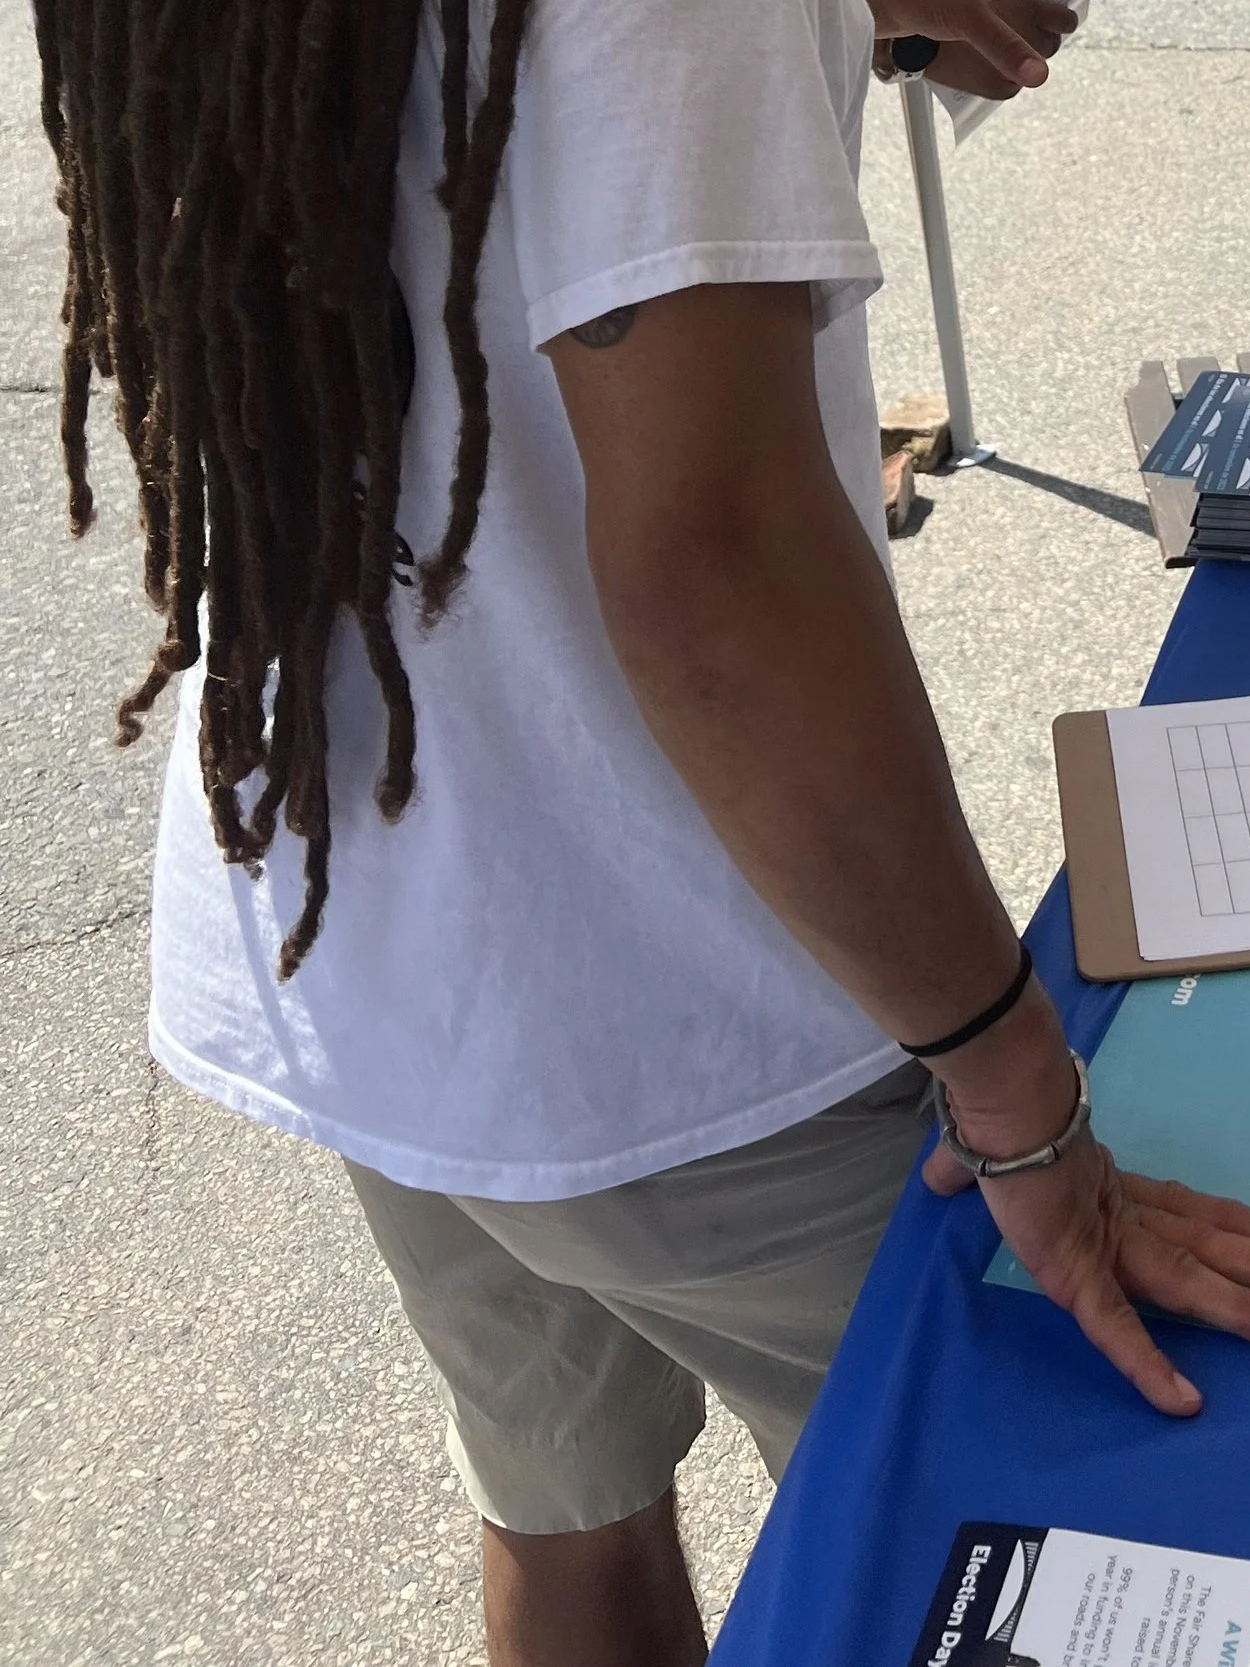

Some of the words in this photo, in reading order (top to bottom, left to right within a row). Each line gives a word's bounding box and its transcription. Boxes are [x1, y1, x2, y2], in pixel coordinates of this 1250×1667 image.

[1105, 1554, 1117, 1579] year
[948, 1545, 990, 1625] Election
[1084, 1572, 1095, 1592] our
[1100, 1581, 1112, 1592] in
[1116, 1567, 1132, 1592] 99%
[1184, 1574, 1195, 1589] on
[1113, 1595, 1123, 1609] of
[1161, 1568, 1179, 1616] person's
[1178, 1592, 1192, 1613] this
[1196, 1586, 1211, 1607] The
[1073, 1594, 1089, 1626] roads
[1084, 1596, 1108, 1639] funding
[1107, 1611, 1118, 1625] us
[1192, 1610, 1205, 1631] Fair
[1134, 1617, 1150, 1652] raised
[1225, 1620, 1241, 1634] A
[1066, 1629, 1079, 1651] and
[1082, 1642, 1094, 1656] to
[1097, 1627, 1113, 1661] won't
[1151, 1619, 1166, 1658] annual
[1182, 1634, 1199, 1666] Share
